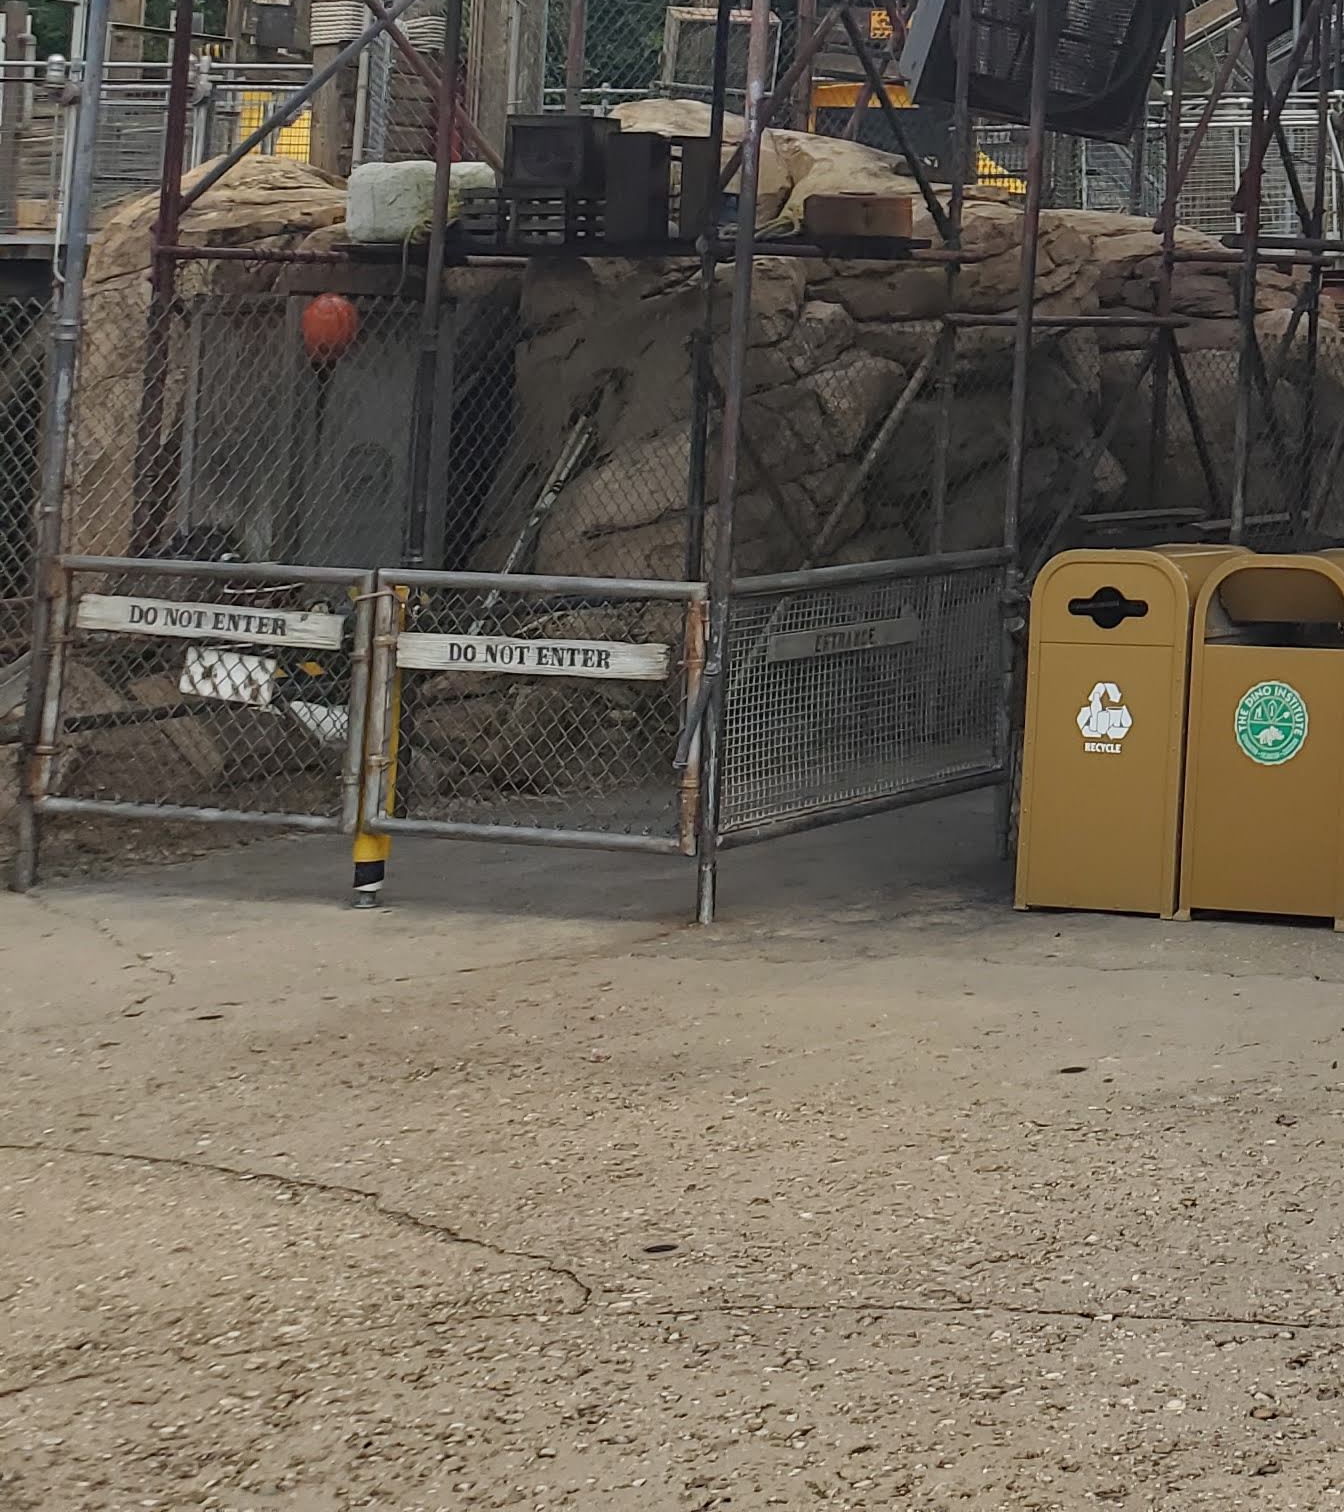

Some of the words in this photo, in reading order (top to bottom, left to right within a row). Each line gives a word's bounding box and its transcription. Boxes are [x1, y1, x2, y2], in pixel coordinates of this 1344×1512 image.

[128, 604, 158, 625] DO
[163, 607, 207, 629] NOT
[211, 611, 287, 637] ENTER
[448, 642, 477, 662] DO
[484, 644, 530, 665] NOT
[535, 646, 611, 670] ENTER
[1238, 708, 1249, 733] THE
[1245, 686, 1272, 707] DINO
[1274, 686, 1304, 736] INSTITUTE
[1084, 742, 1122, 754] RECYCLE
